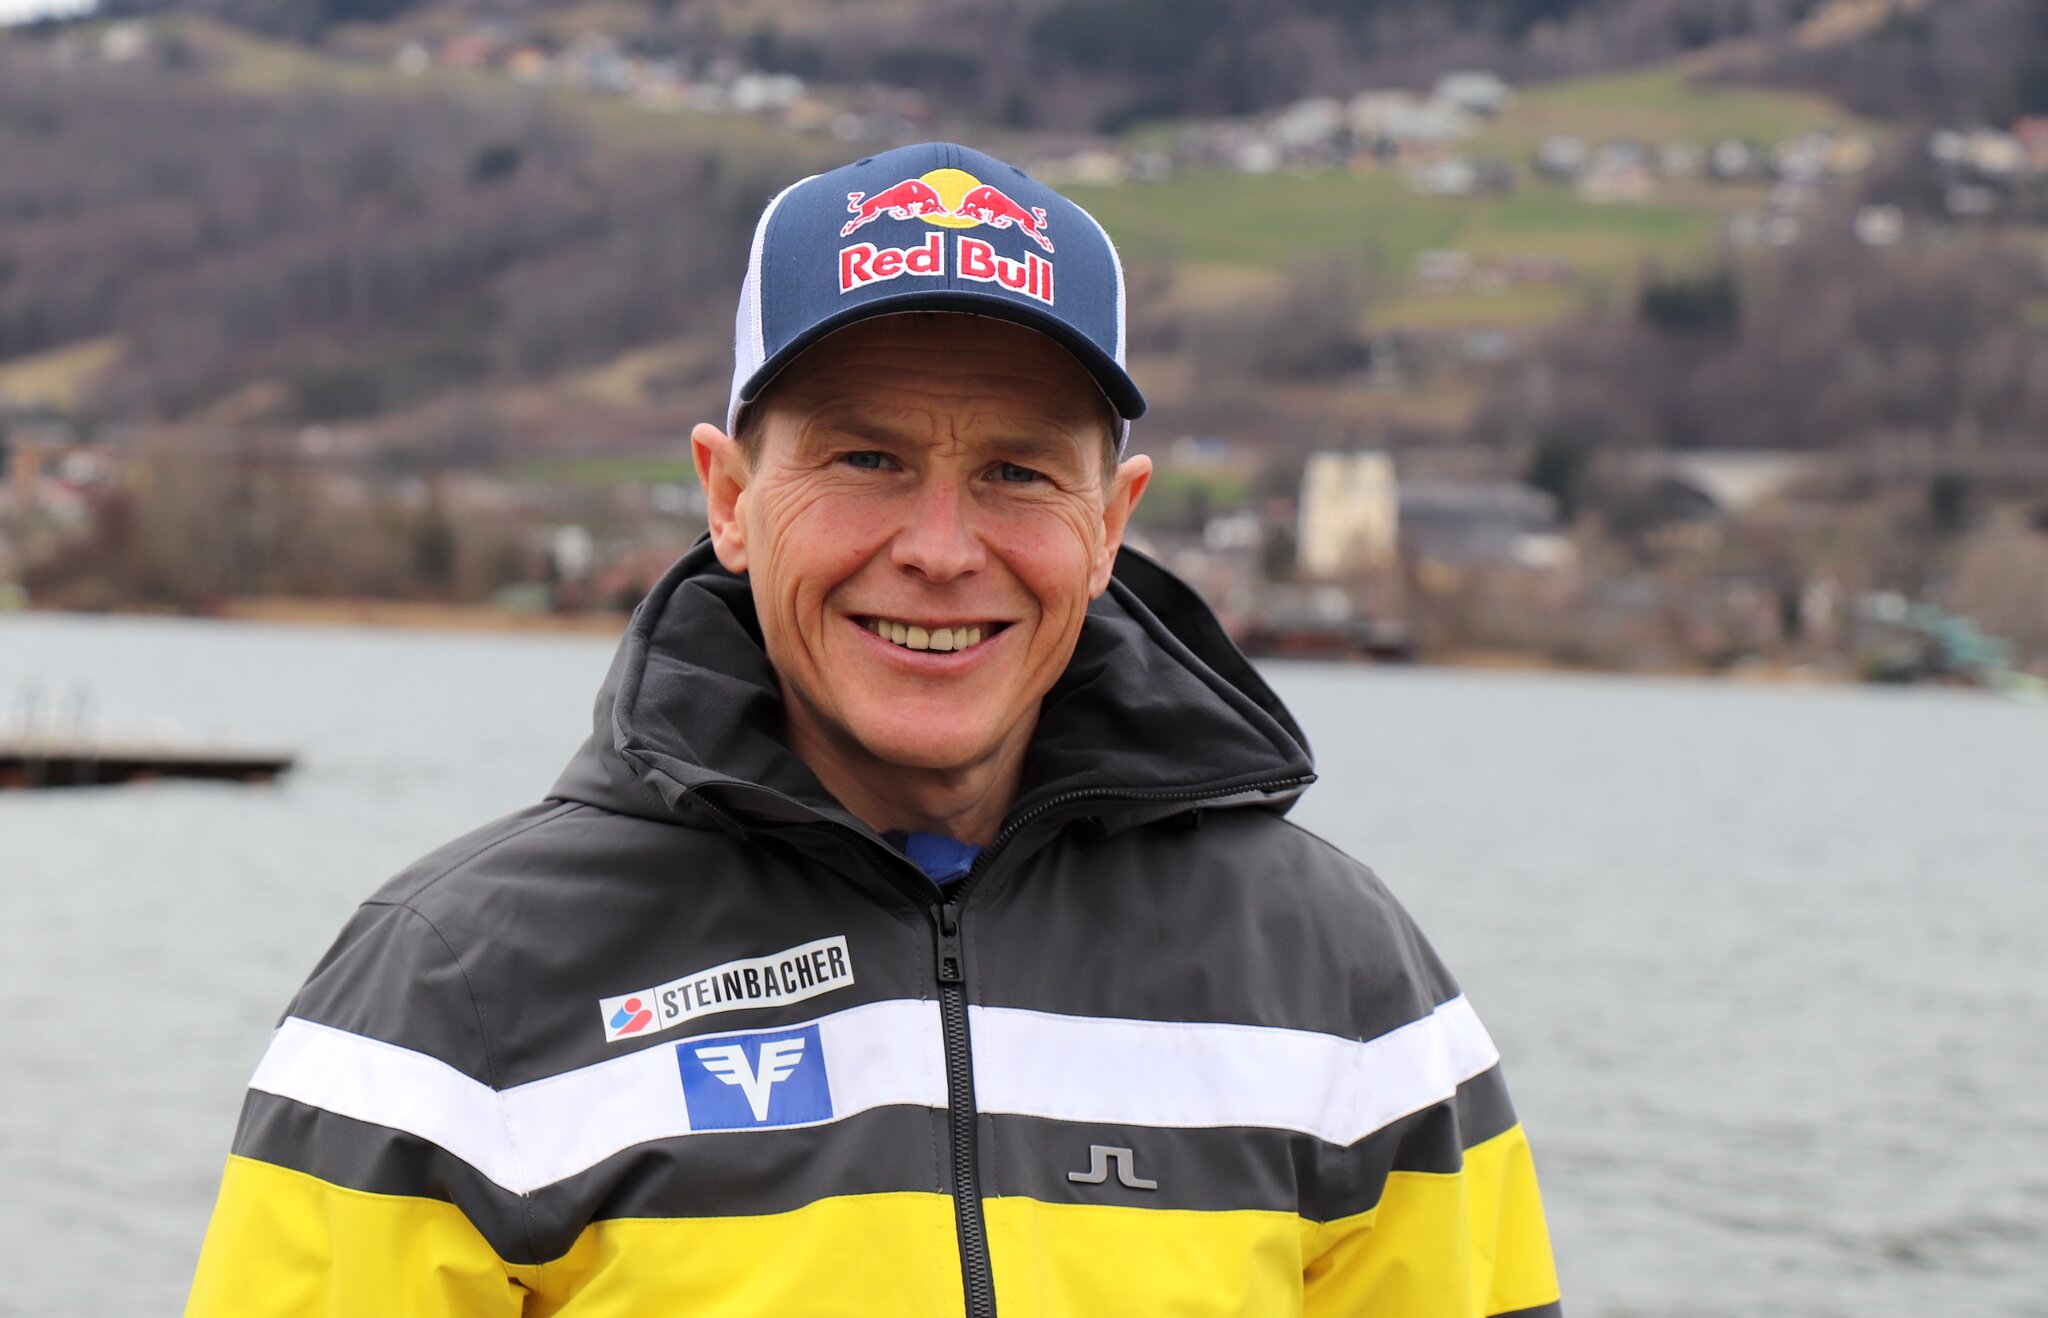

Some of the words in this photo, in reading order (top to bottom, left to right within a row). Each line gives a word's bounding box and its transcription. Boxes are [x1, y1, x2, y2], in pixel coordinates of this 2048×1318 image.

[840, 234, 941, 291] Red
[960, 238, 1052, 302] Bull
[662, 946, 847, 1019] STEINBACHER
